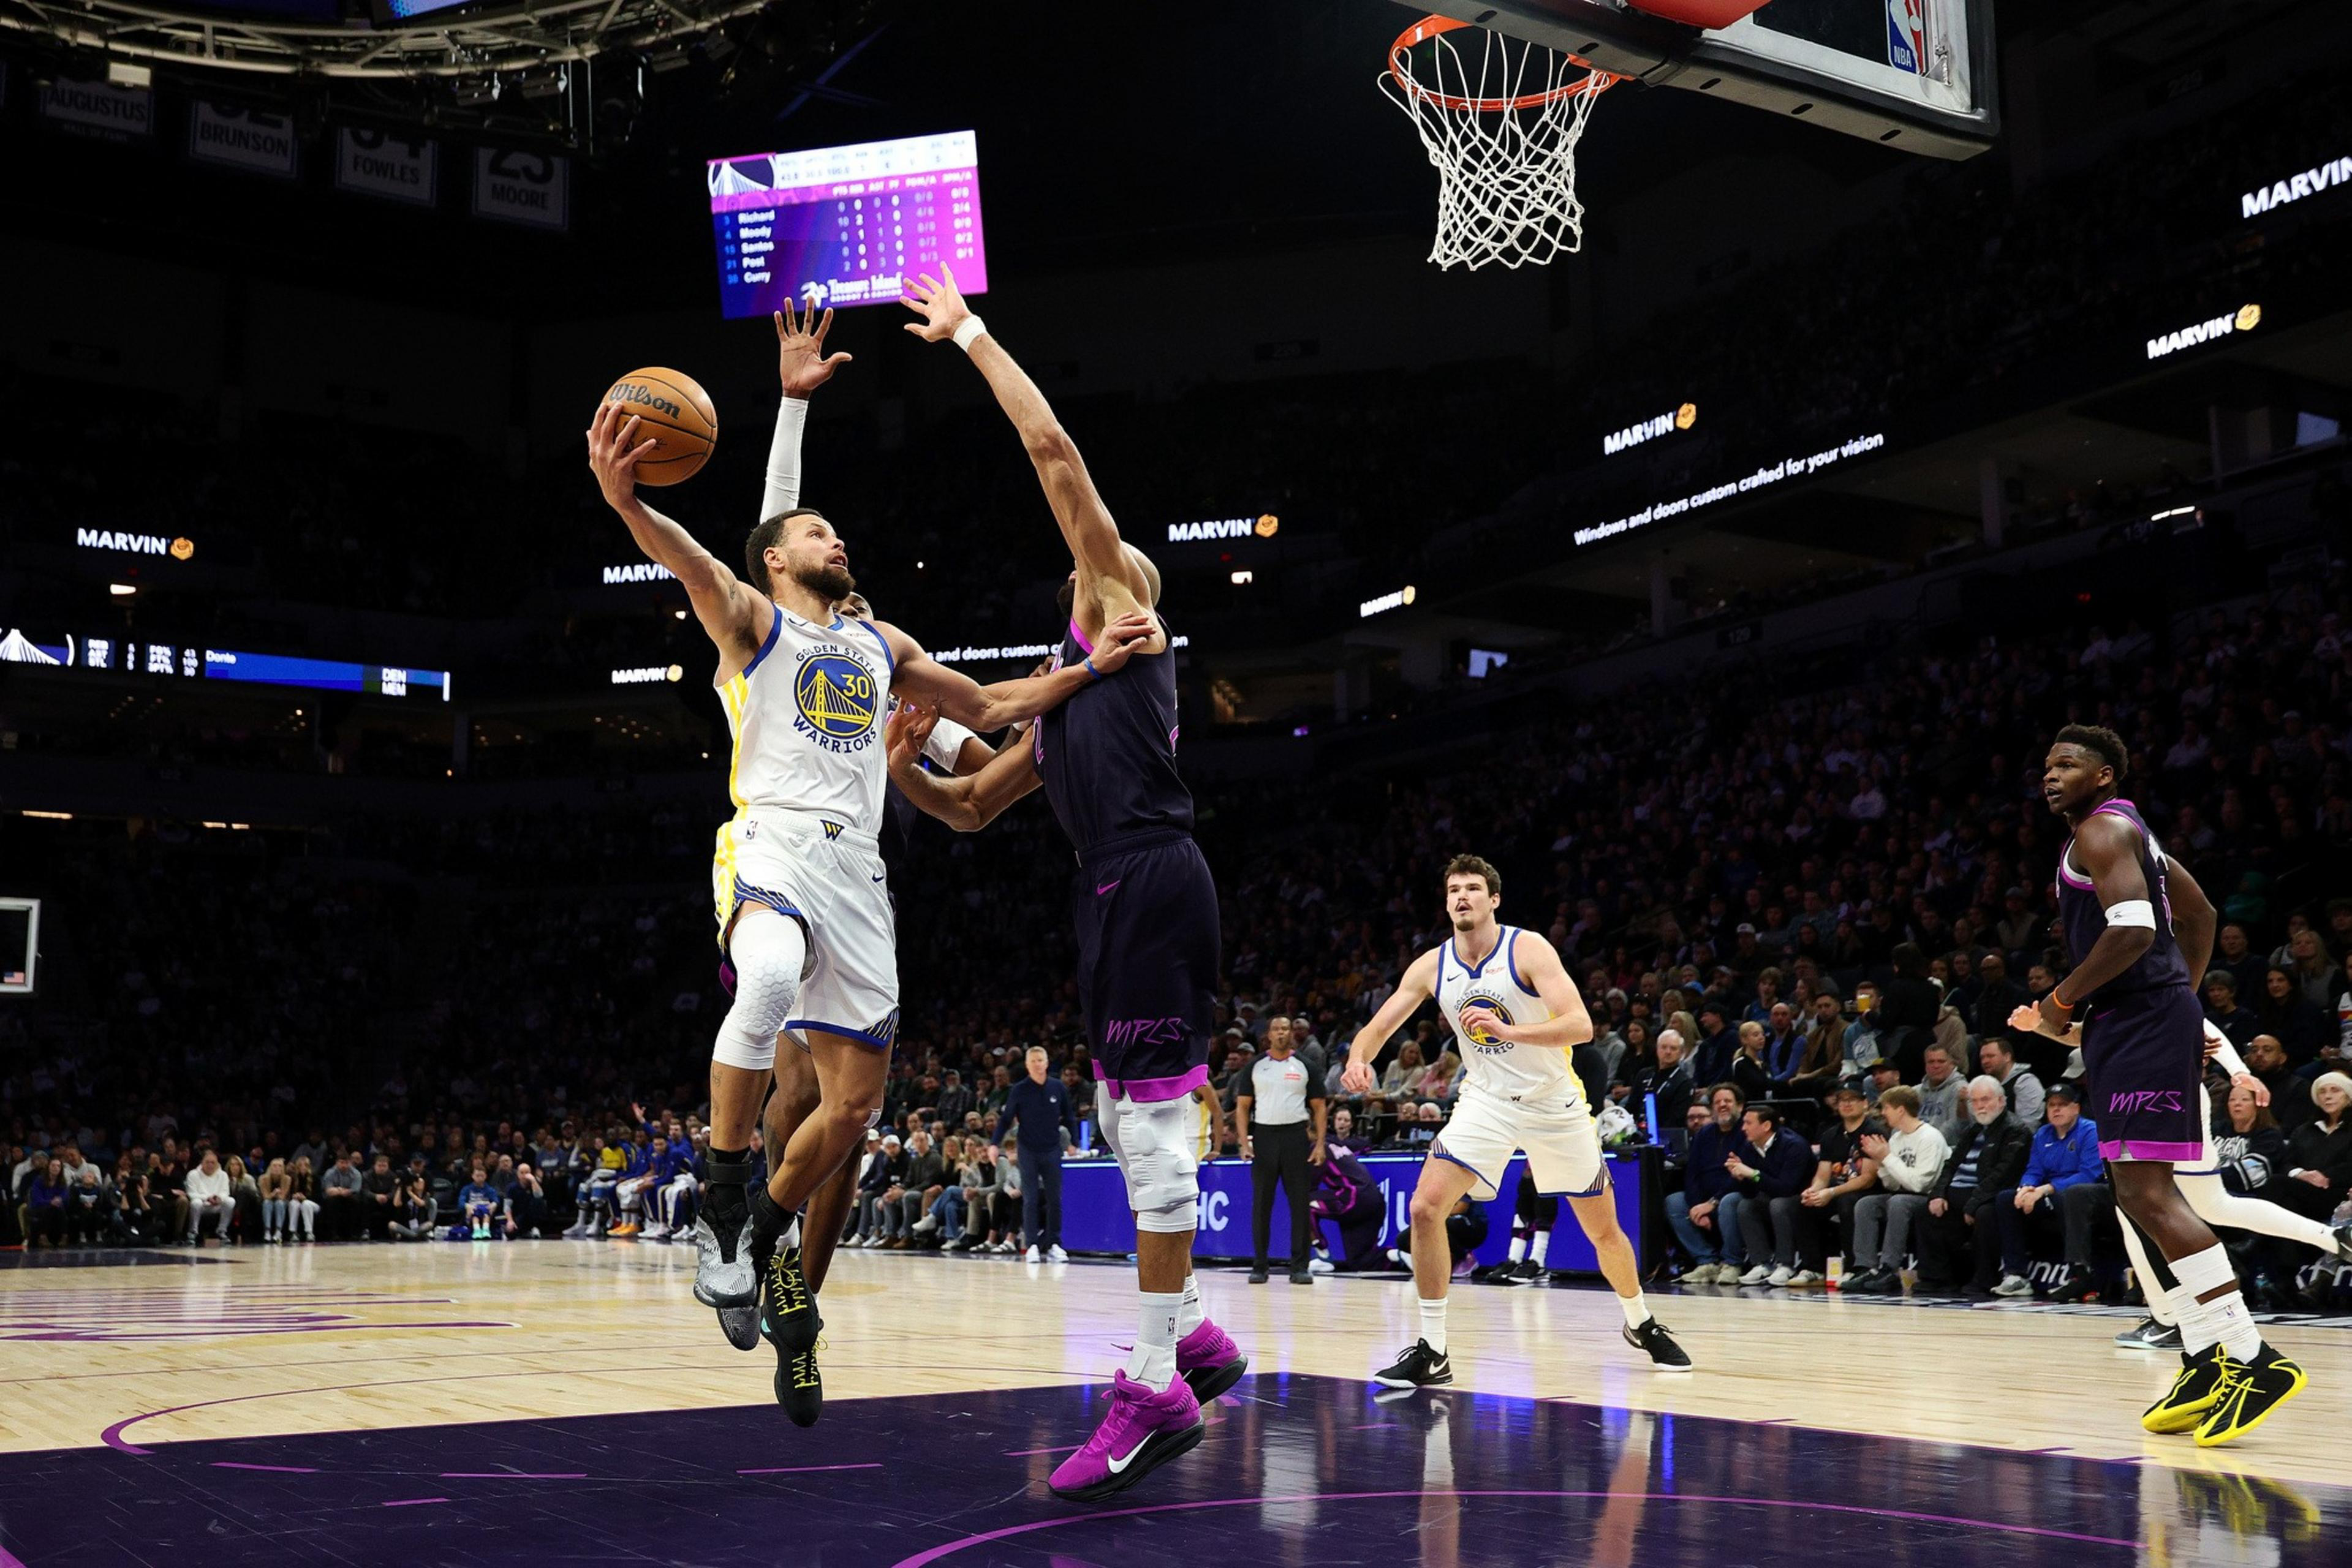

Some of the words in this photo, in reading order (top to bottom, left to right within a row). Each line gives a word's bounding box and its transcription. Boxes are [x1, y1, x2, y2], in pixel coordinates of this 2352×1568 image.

[1894, 45, 1912, 68] NBA
[48, 87, 146, 122] AUGUSTUS
[200, 121, 289, 157] BRUNSON
[353, 154, 420, 184] FOWLES
[491, 184, 549, 209] MOORE
[2147, 315, 2233, 359] MARVIN
[609, 383, 681, 420] Wilson
[1605, 412, 1674, 454] MARVIN
[1574, 519, 1627, 545] Windows
[1628, 506, 1652, 528] and
[1653, 502, 1689, 520] doors
[1690, 482, 1737, 508] custom
[1738, 462, 1784, 492] crafted
[1785, 458, 1806, 476] for
[1807, 448, 1839, 473] your
[1840, 433, 1884, 458] vision
[78, 528, 165, 554] MARVIN
[1169, 518, 1252, 541] MARVIN
[206, 650, 236, 665] Donte
[796, 644, 838, 662] GOLDEN
[844, 647, 876, 674] STATE
[935, 647, 961, 662] and
[962, 646, 1000, 660] doors
[1001, 643, 1049, 658] custom
[382, 668, 407, 683] DEN
[612, 668, 665, 684] MARVIN
[841, 674, 870, 699] 30
[382, 682, 406, 696] MEM
[792, 713, 877, 753] WARRIORS
[1454, 989, 1480, 1010] GOLDEN
[1483, 989, 1505, 1003] STATE
[1472, 1041, 1514, 1055] ARRIO
